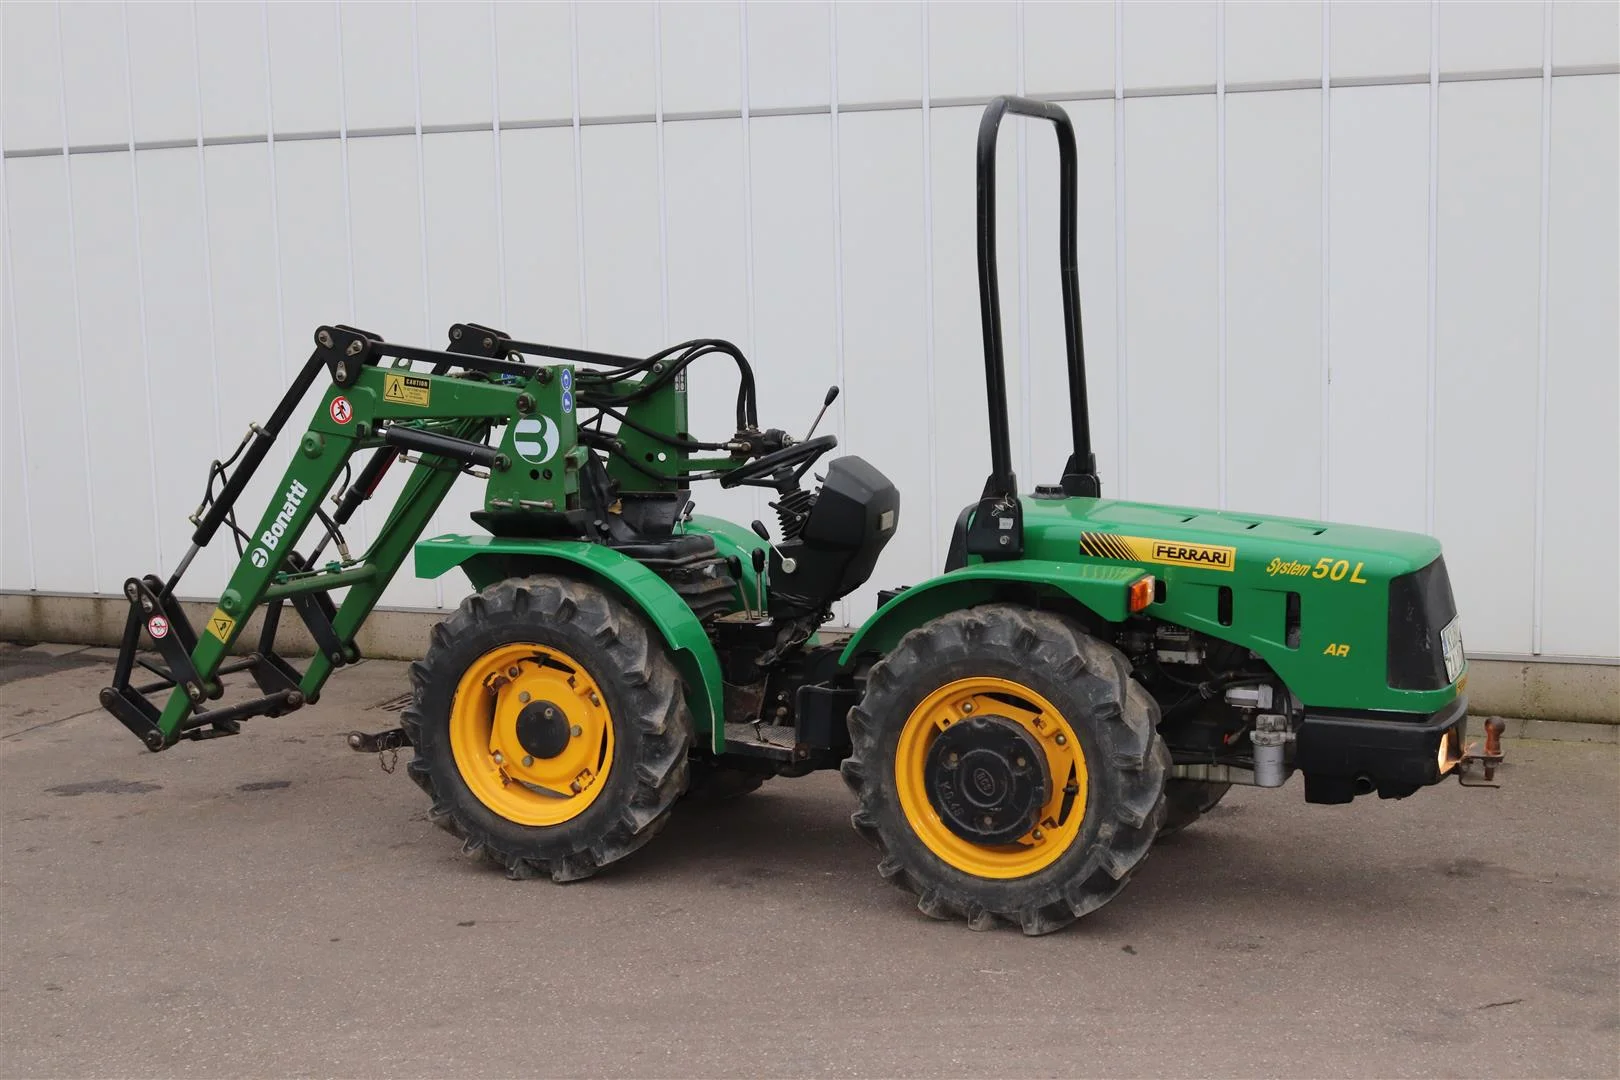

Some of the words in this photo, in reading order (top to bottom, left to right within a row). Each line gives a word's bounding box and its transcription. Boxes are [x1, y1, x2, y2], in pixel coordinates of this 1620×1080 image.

[406, 378, 428, 387] CAUTION
[261, 479, 308, 551] Bonatti
[1156, 545, 1227, 564] FERRARI
[1266, 557, 1312, 577] System
[1312, 557, 1349, 581] 50
[1323, 643, 1350, 657] AR
